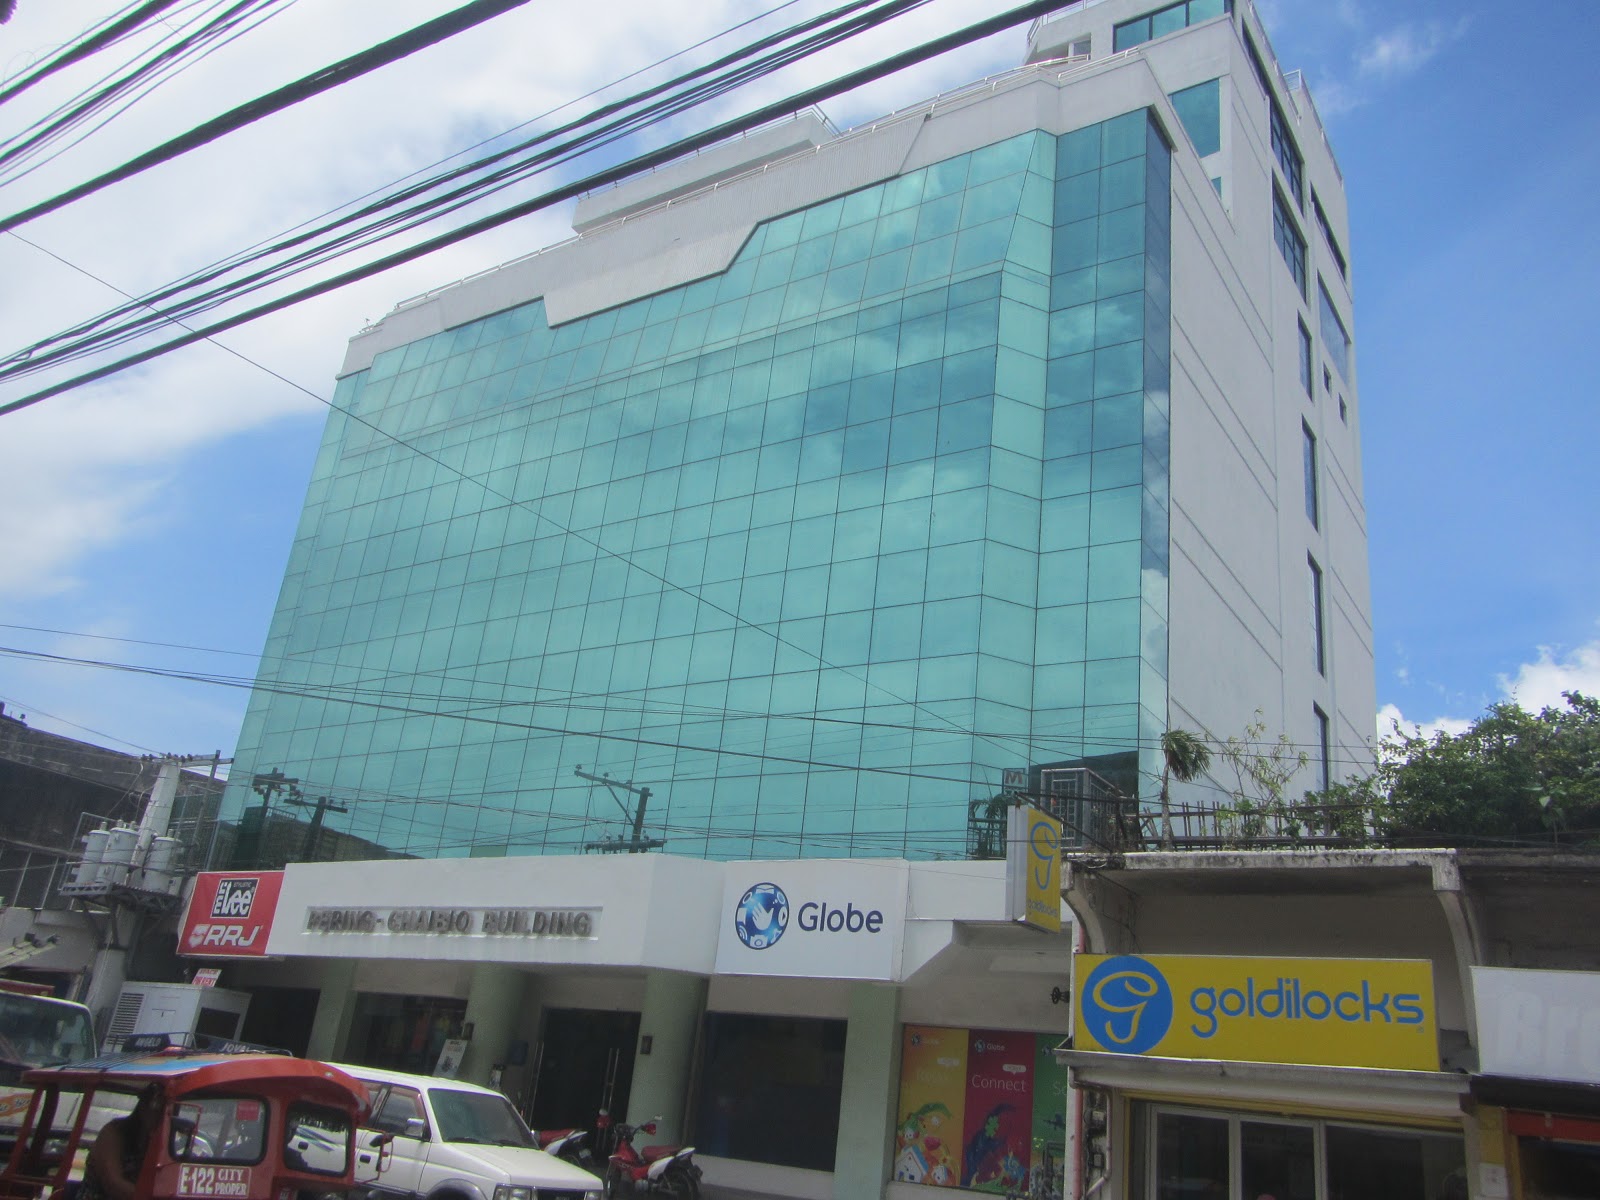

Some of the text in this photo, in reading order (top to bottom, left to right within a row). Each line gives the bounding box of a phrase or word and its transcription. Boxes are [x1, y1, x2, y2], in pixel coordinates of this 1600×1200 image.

[481, 911, 591, 937] BUILDING
[797, 902, 884, 933] Globe
[203, 925, 260, 946] RRJ
[1190, 977, 1425, 1038] goldilocks
[986, 1043, 1005, 1052] Globe
[971, 1075, 1026, 1093] Connect
[218, 1168, 244, 1181] CITY
[214, 1182, 247, 1195] PROPER
